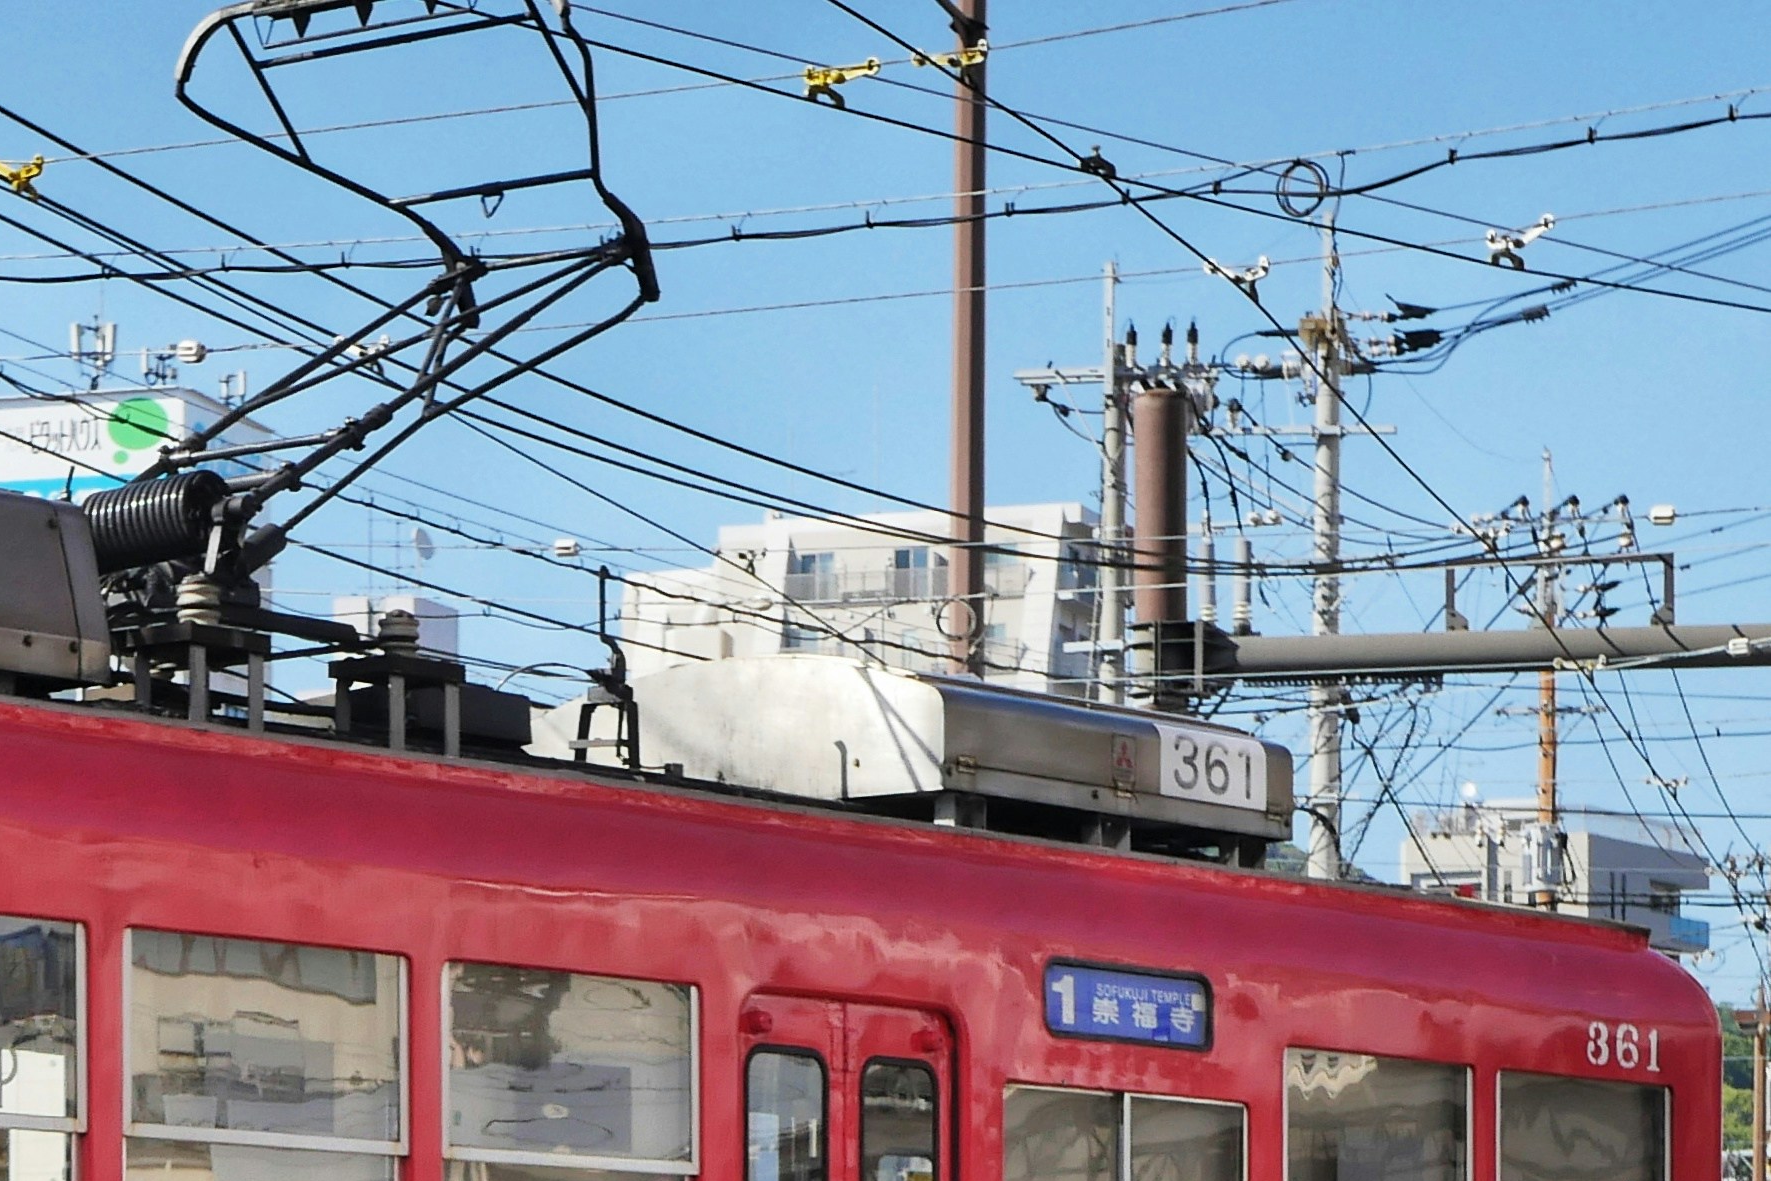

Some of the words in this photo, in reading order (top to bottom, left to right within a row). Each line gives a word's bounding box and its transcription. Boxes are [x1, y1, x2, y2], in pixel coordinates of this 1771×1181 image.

[1174, 735, 1252, 800] 361
[1051, 974, 1075, 1025] 1
[1093, 997, 1196, 1034] 崇福寺
[1096, 983, 1148, 1001] SOFUKUJI
[1151, 989, 1192, 1007] TEMPLE
[1586, 1021, 1661, 1073] 361
